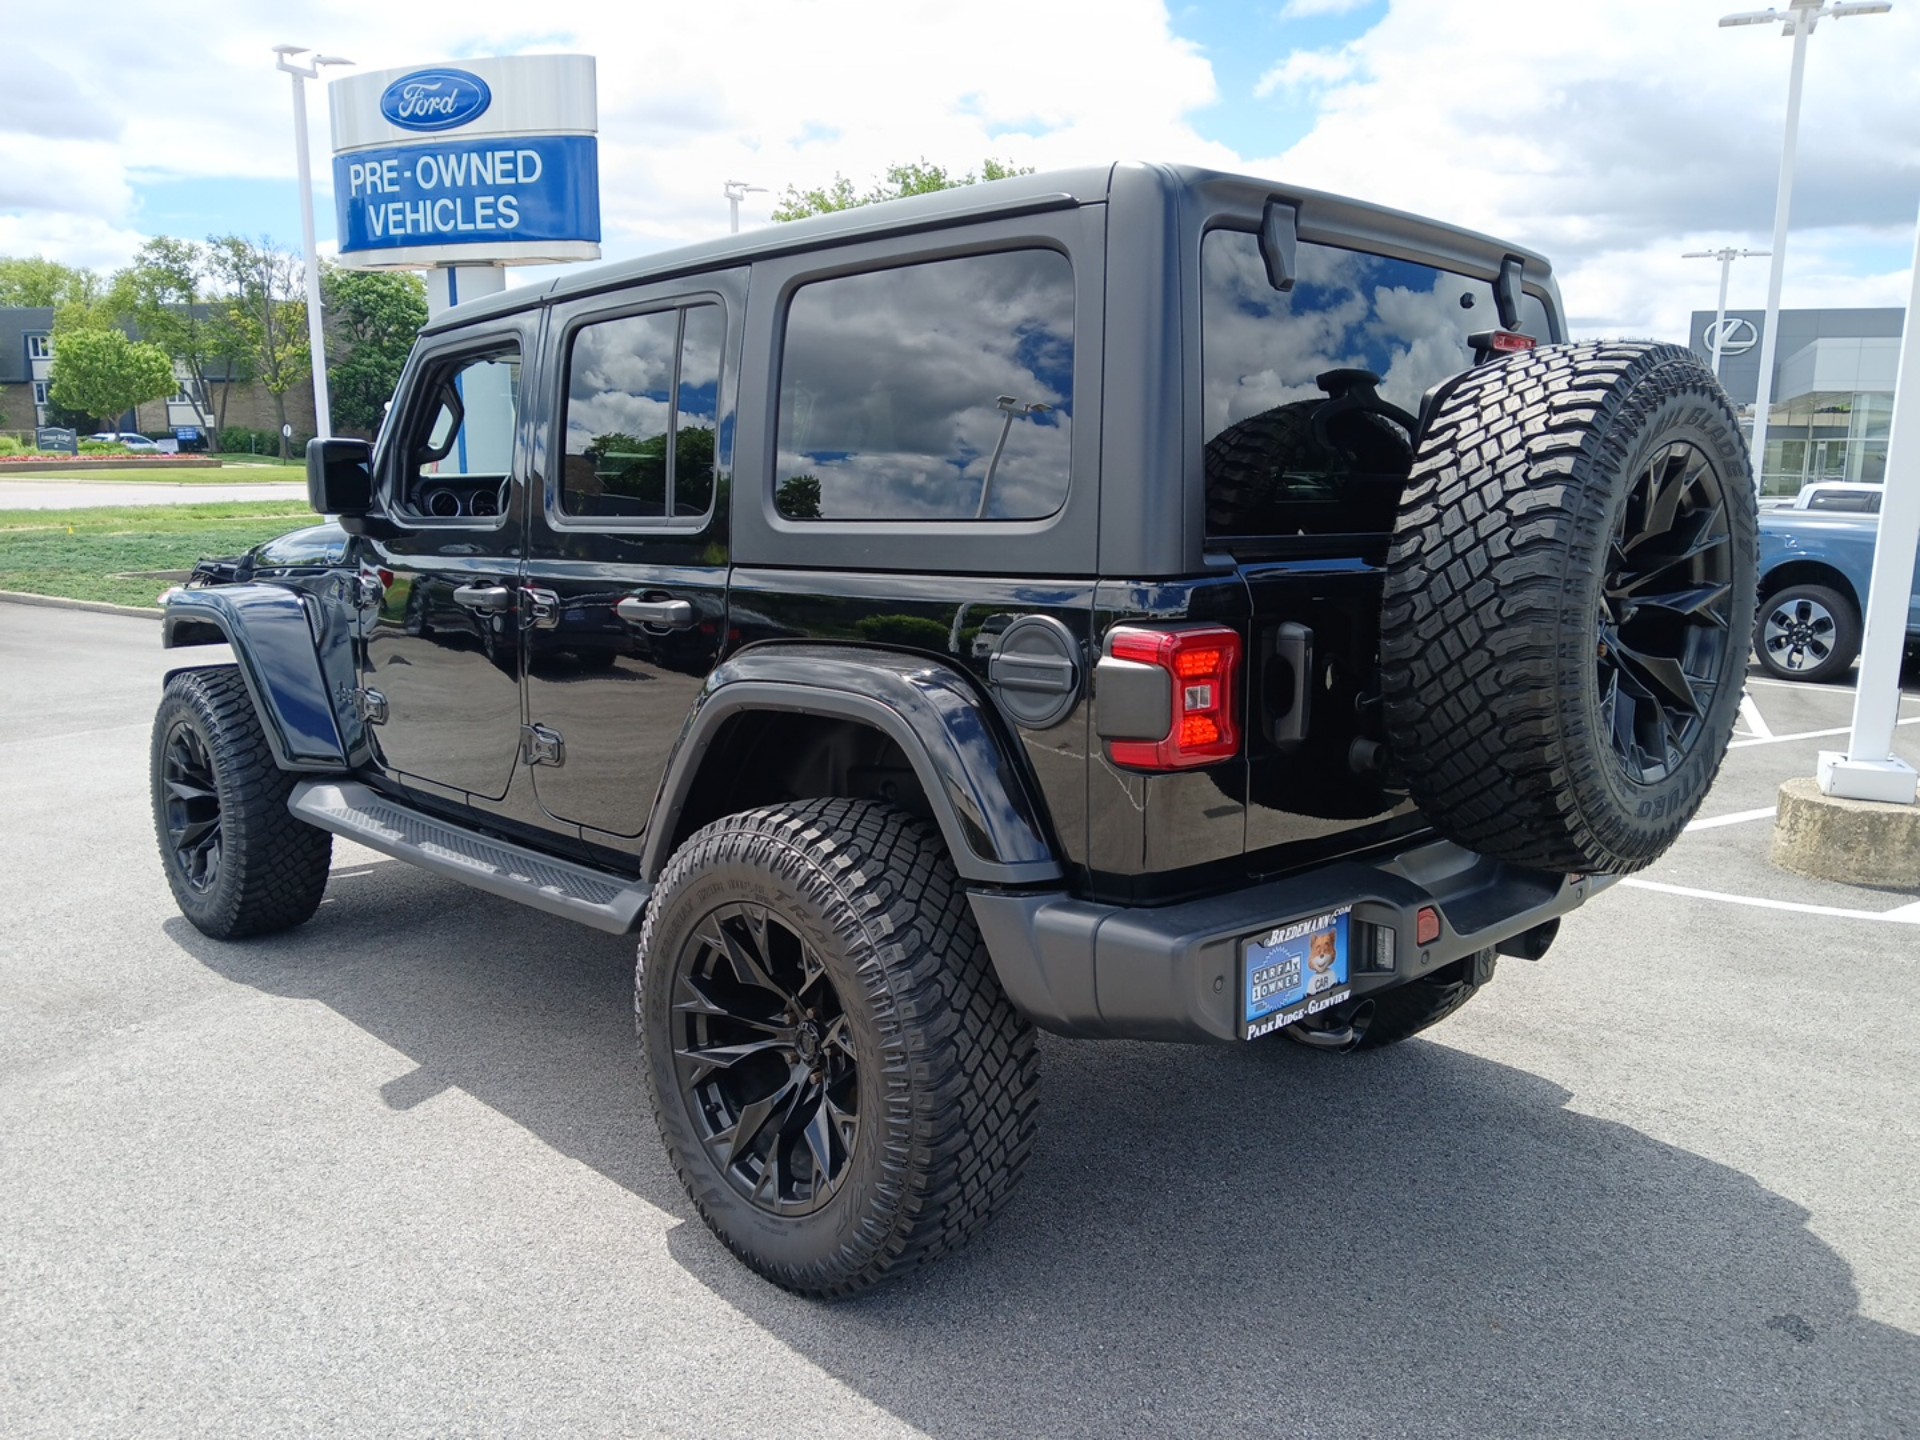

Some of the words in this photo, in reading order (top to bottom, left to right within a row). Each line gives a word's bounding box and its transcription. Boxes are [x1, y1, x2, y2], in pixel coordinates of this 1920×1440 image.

[399, 82, 458, 117] Ford
[350, 150, 542, 196] PRE-OWNED
[368, 195, 519, 236] VEHICLES
[1684, 407, 1744, 478] BLADE
[1253, 960, 1300, 985] CARFAX
[1315, 976, 1329, 991] CAR
[1247, 1020, 1274, 1040] PARK
